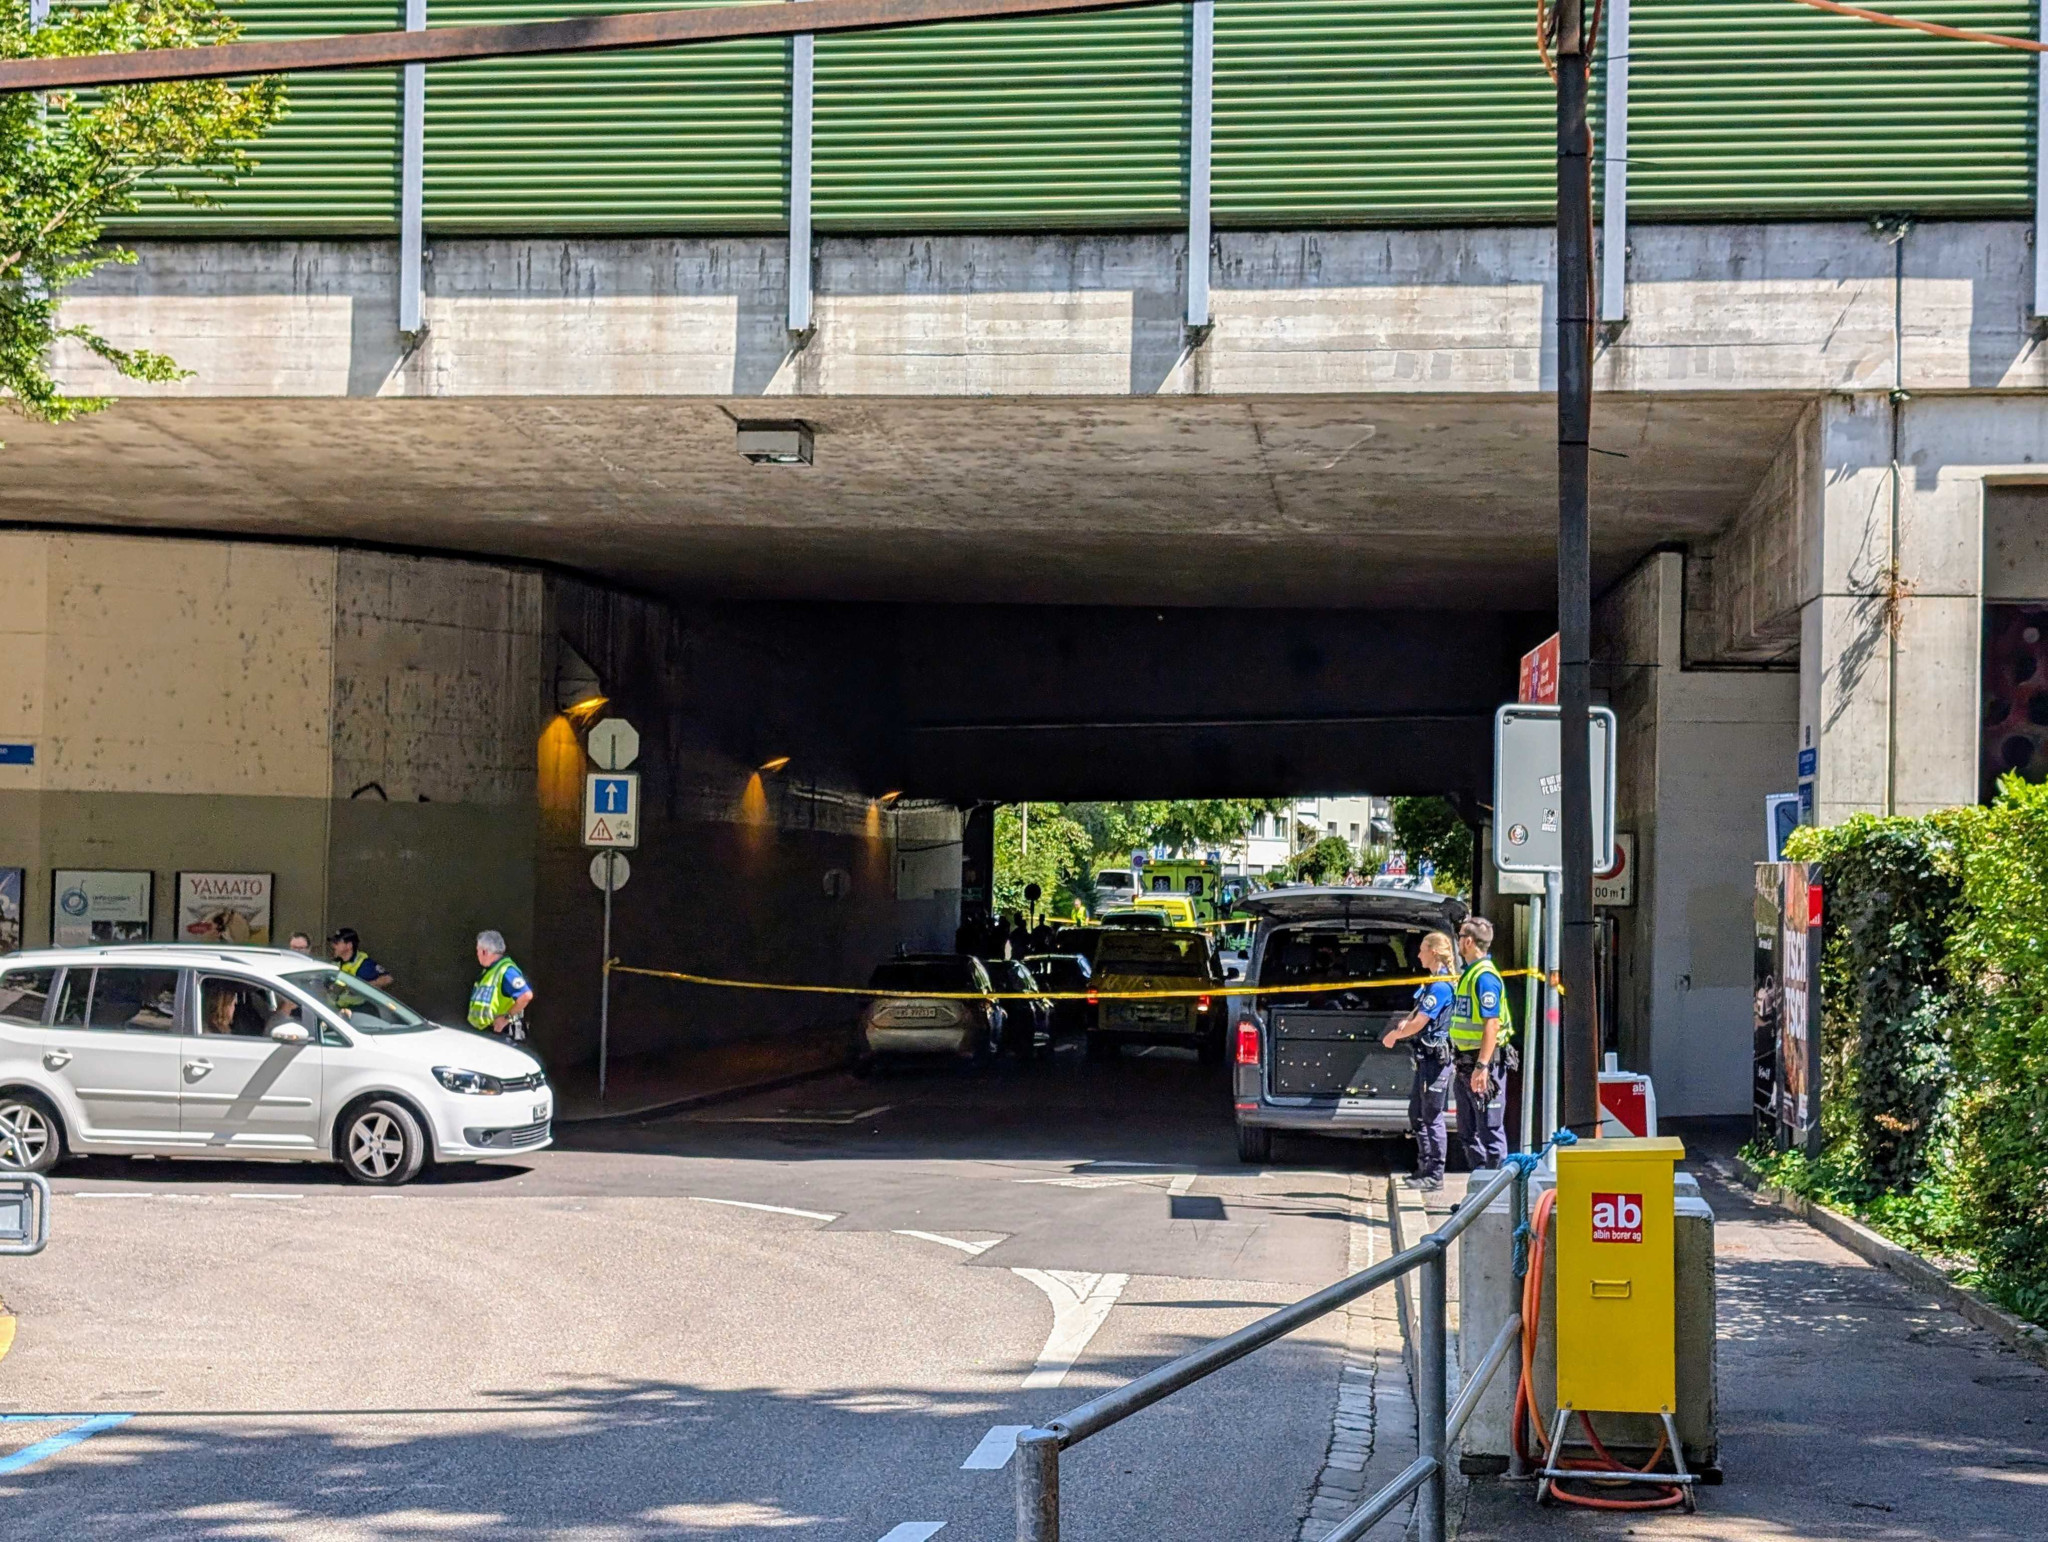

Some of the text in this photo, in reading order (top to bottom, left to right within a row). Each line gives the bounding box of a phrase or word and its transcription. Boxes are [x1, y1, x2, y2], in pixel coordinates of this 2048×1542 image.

[1550, 783, 1561, 794] BAS
[190, 879, 263, 896] YAMATO
[1632, 1081, 1645, 1093] ab
[1593, 1195, 1641, 1229] ab
[1593, 1230, 1642, 1242] albin borer ag
